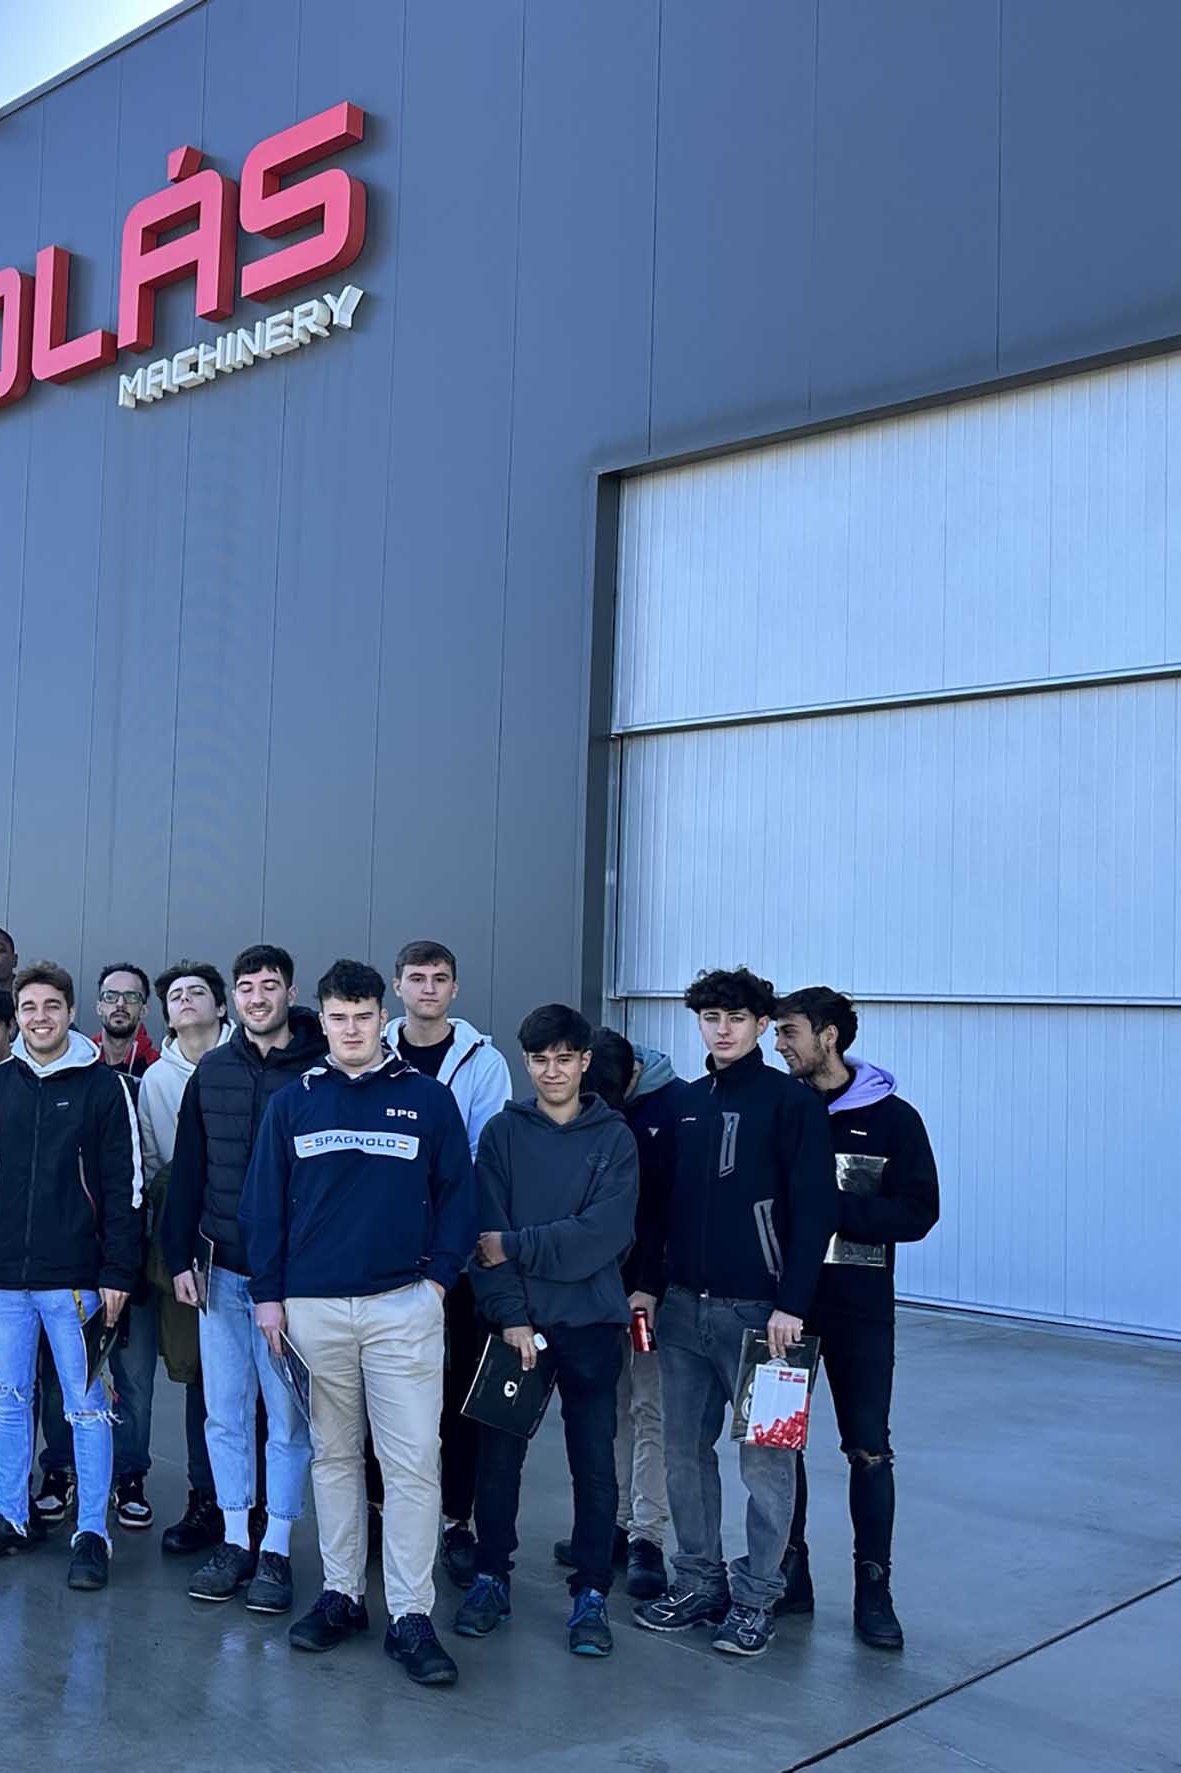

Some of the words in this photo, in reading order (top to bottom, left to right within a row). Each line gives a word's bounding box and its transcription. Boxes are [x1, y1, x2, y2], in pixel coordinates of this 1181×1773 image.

[119, 285, 364, 408] MACHINERY
[386, 1108, 418, 1120] SPG
[314, 1135, 397, 1149] SPAGNOLO
